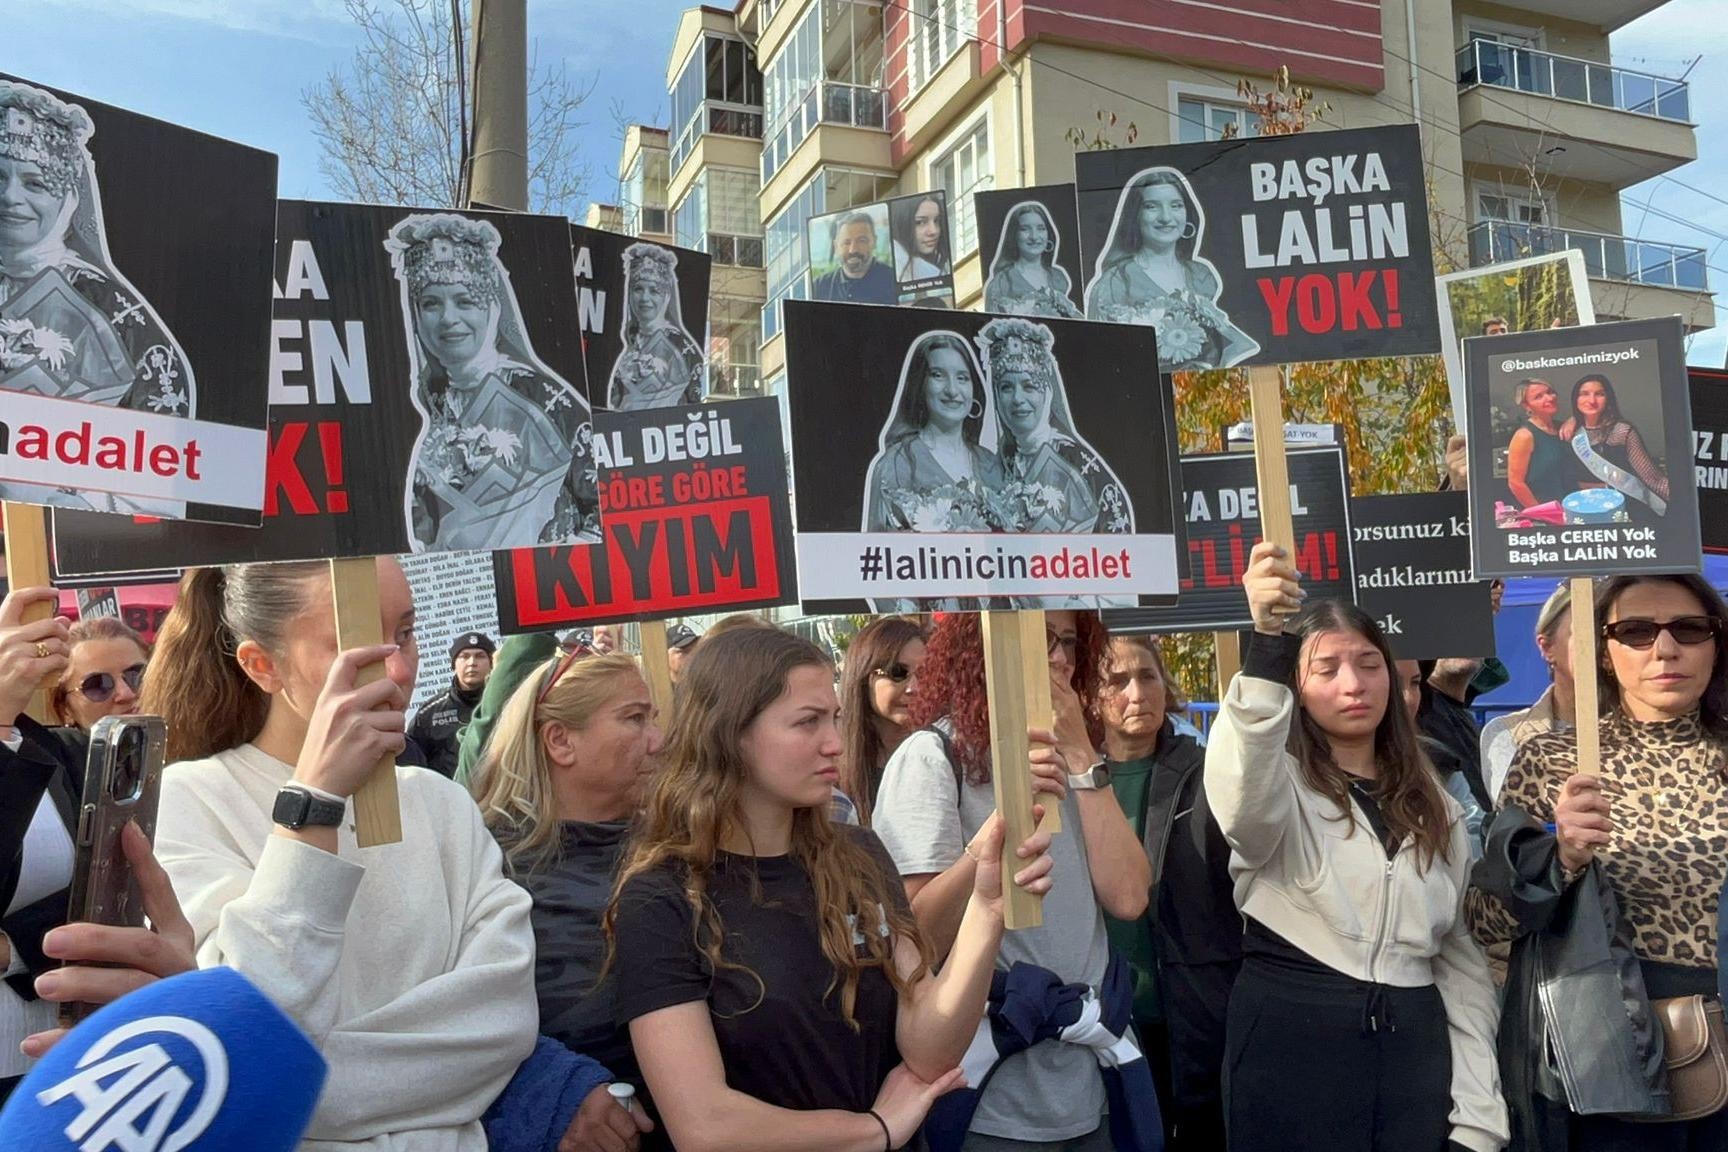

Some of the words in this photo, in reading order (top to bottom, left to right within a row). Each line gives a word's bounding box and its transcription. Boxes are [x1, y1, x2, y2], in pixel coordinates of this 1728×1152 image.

[1250, 152, 1391, 205] BAŞKA
[1256, 269, 1403, 336] YOK!
[1501, 348, 1640, 373] @baskacanimizyok
[0, 421, 202, 481] adalet
[641, 410, 742, 464] DEĞİL
[673, 462, 749, 504] GÖRE
[1183, 488, 1211, 522] A
[1219, 484, 1308, 520] DEL
[1508, 531, 1556, 549] Başka
[1560, 528, 1618, 545] CEREN
[1622, 527, 1656, 541] Yok
[1508, 549, 1559, 566] Başka
[1564, 544, 1618, 561] LALİN
[1623, 544, 1657, 560] Yok
[860, 546, 1132, 582] #lalinicinadalet
